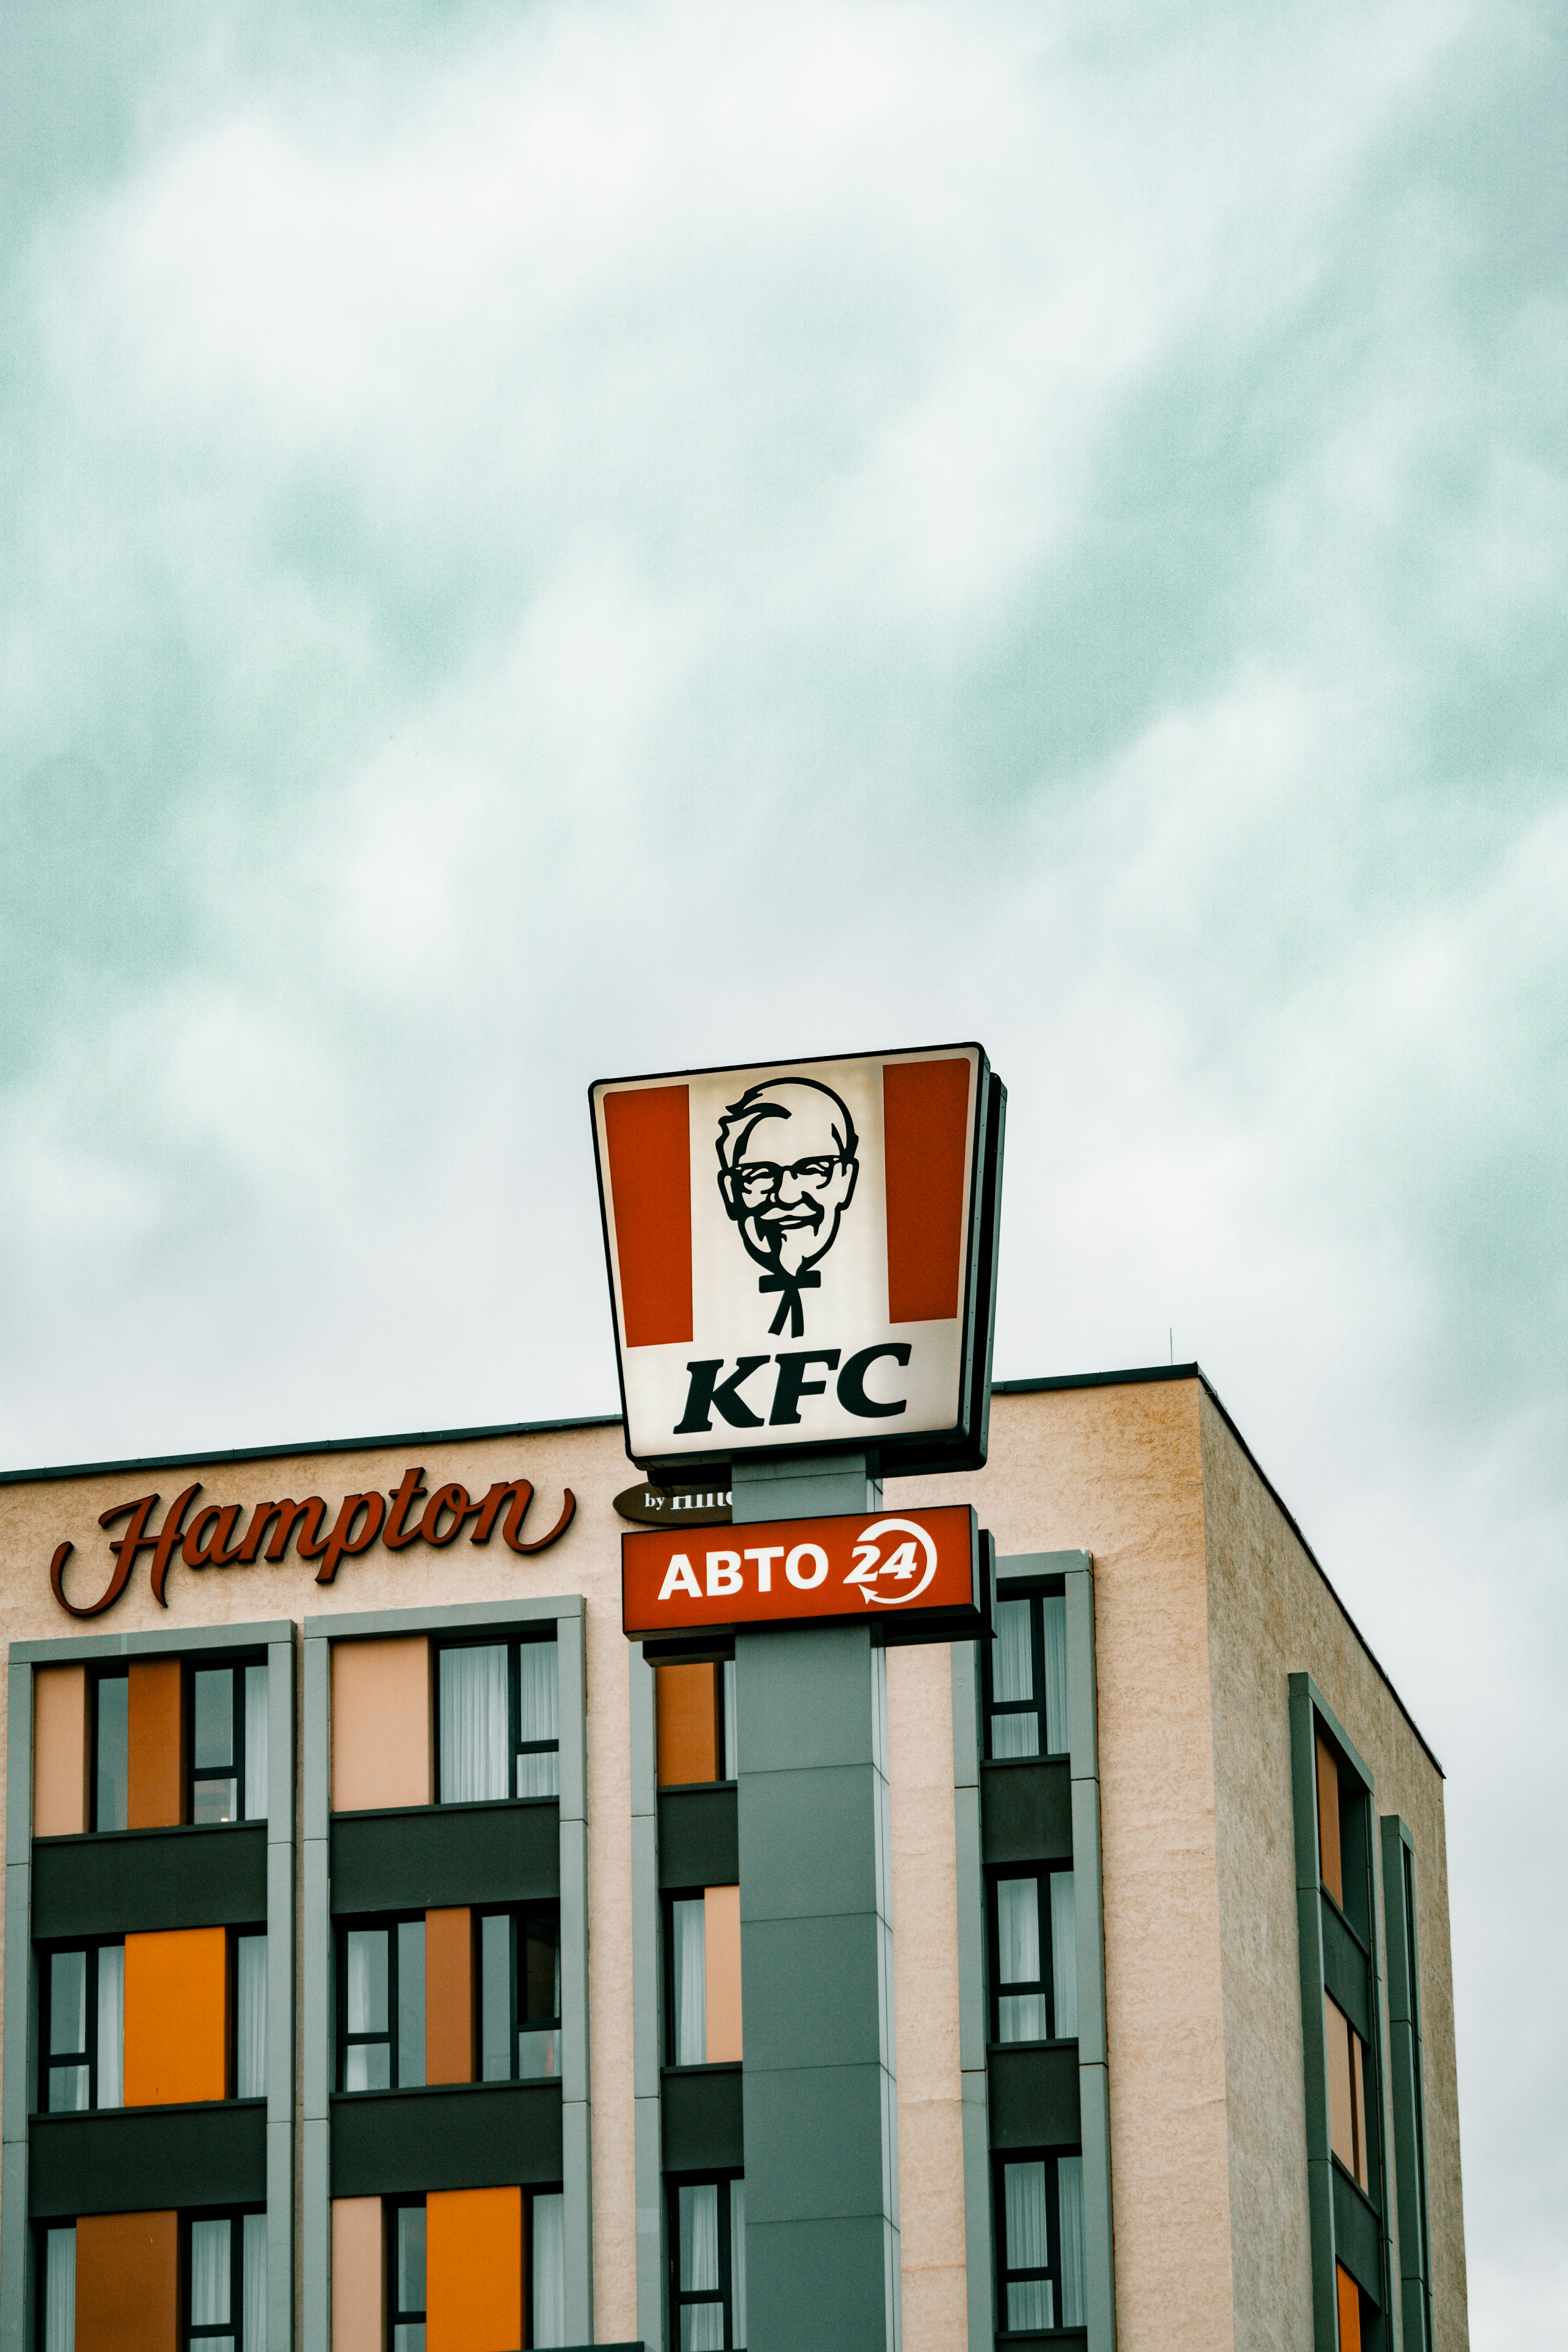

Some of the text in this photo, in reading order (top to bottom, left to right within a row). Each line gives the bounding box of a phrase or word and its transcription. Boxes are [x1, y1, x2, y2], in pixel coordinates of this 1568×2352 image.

[673, 1343, 911, 1434] KFC
[644, 1493, 664, 1510] by
[50, 1467, 577, 1617] Hampton
[658, 1542, 916, 1600] АВТО 24
